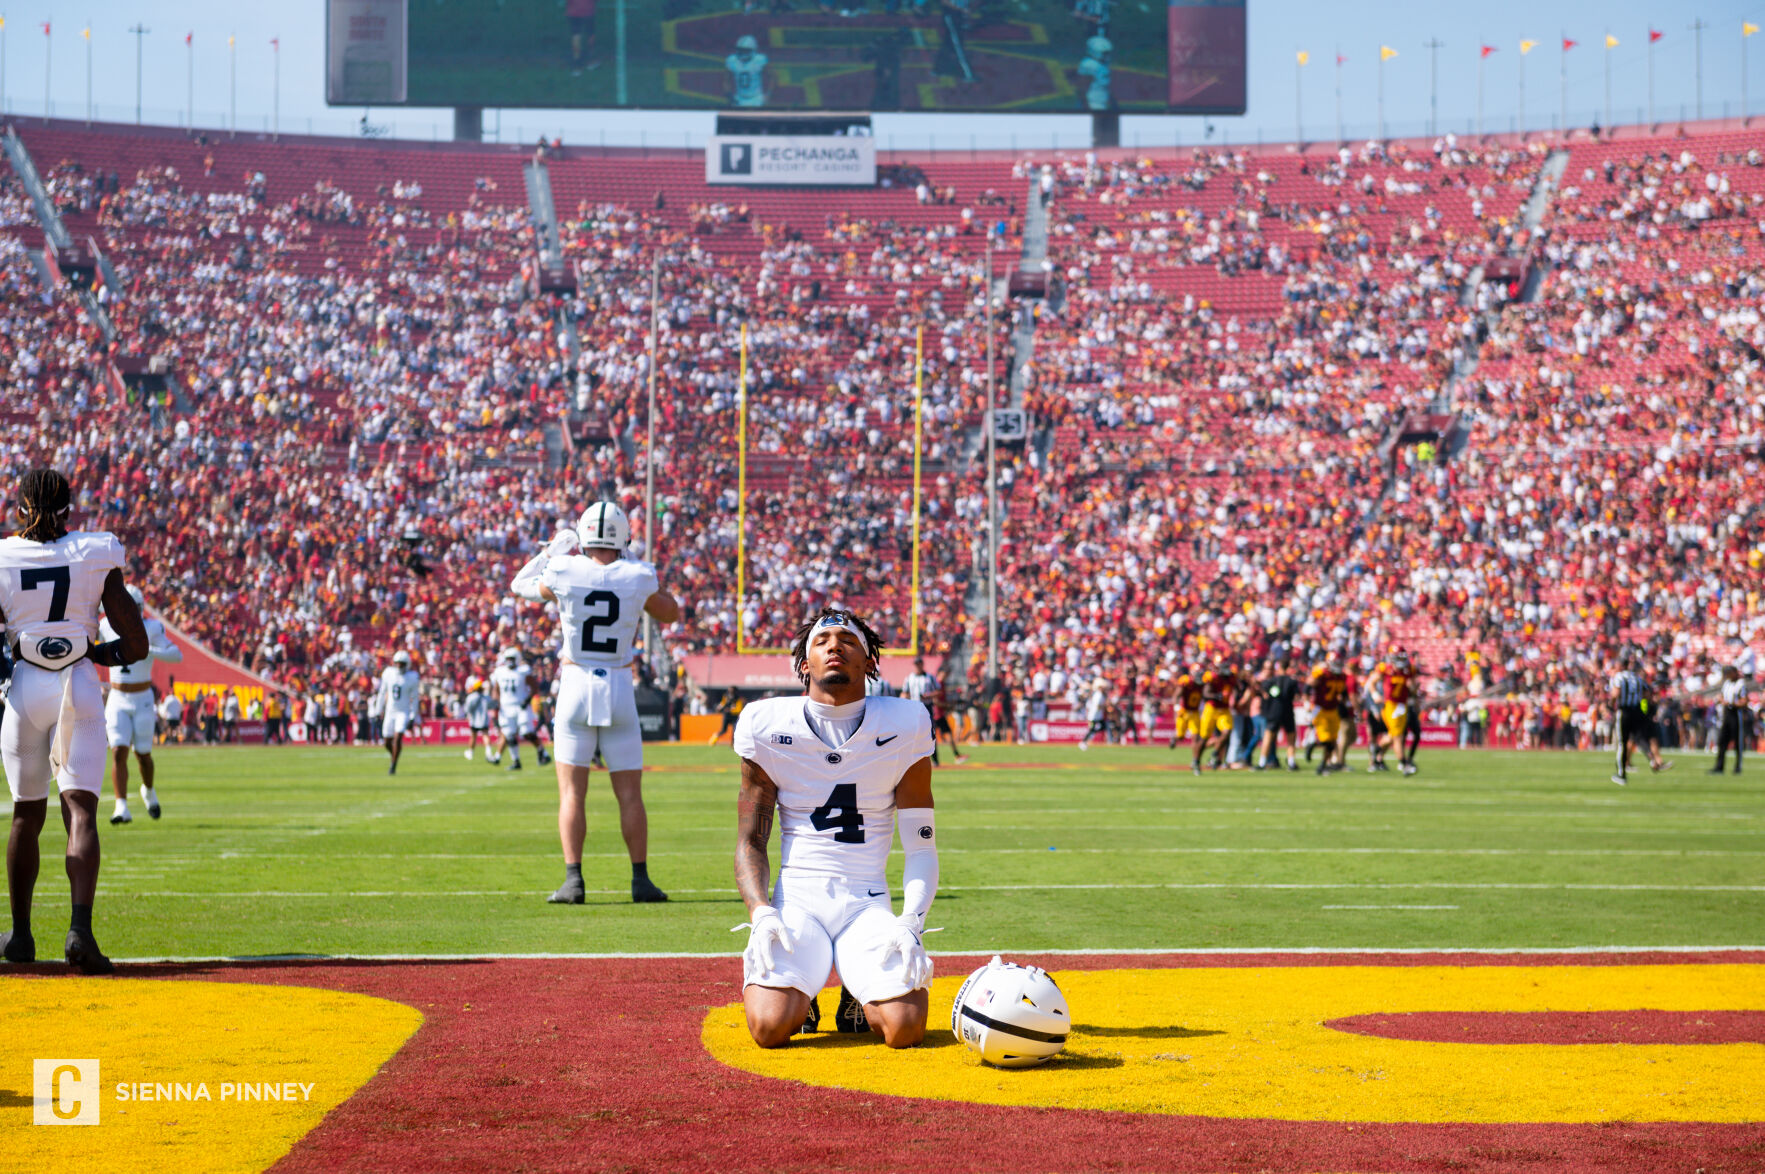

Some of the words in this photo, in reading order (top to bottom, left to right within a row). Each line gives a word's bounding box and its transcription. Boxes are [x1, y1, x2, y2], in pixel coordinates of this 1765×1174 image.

[759, 148, 860, 161] PECHANGA
[759, 163, 807, 173] RESORT
[814, 163, 862, 173] CASINO
[20, 565, 71, 623] 7
[581, 590, 620, 654] 2
[1390, 676, 1405, 698] 7
[809, 783, 866, 844] 4
